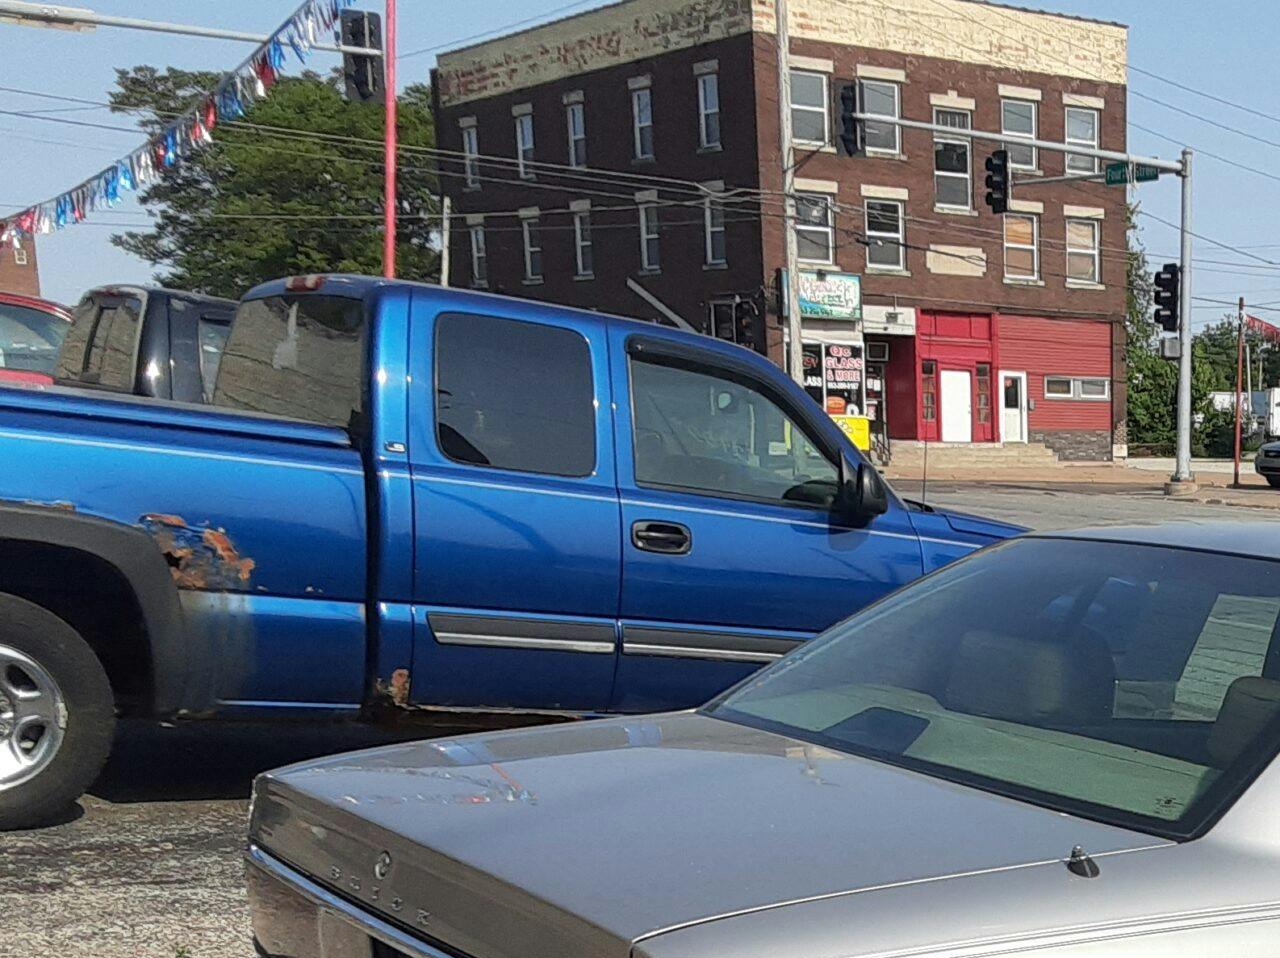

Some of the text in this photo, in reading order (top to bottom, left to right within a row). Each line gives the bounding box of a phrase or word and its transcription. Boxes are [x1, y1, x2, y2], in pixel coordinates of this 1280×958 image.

[1107, 164, 1133, 180] Fourt
[825, 357, 863, 369] GLASS
[804, 376, 822, 387] ASS
[827, 370, 861, 382] & MORE
[328, 864, 431, 926] BUICK
